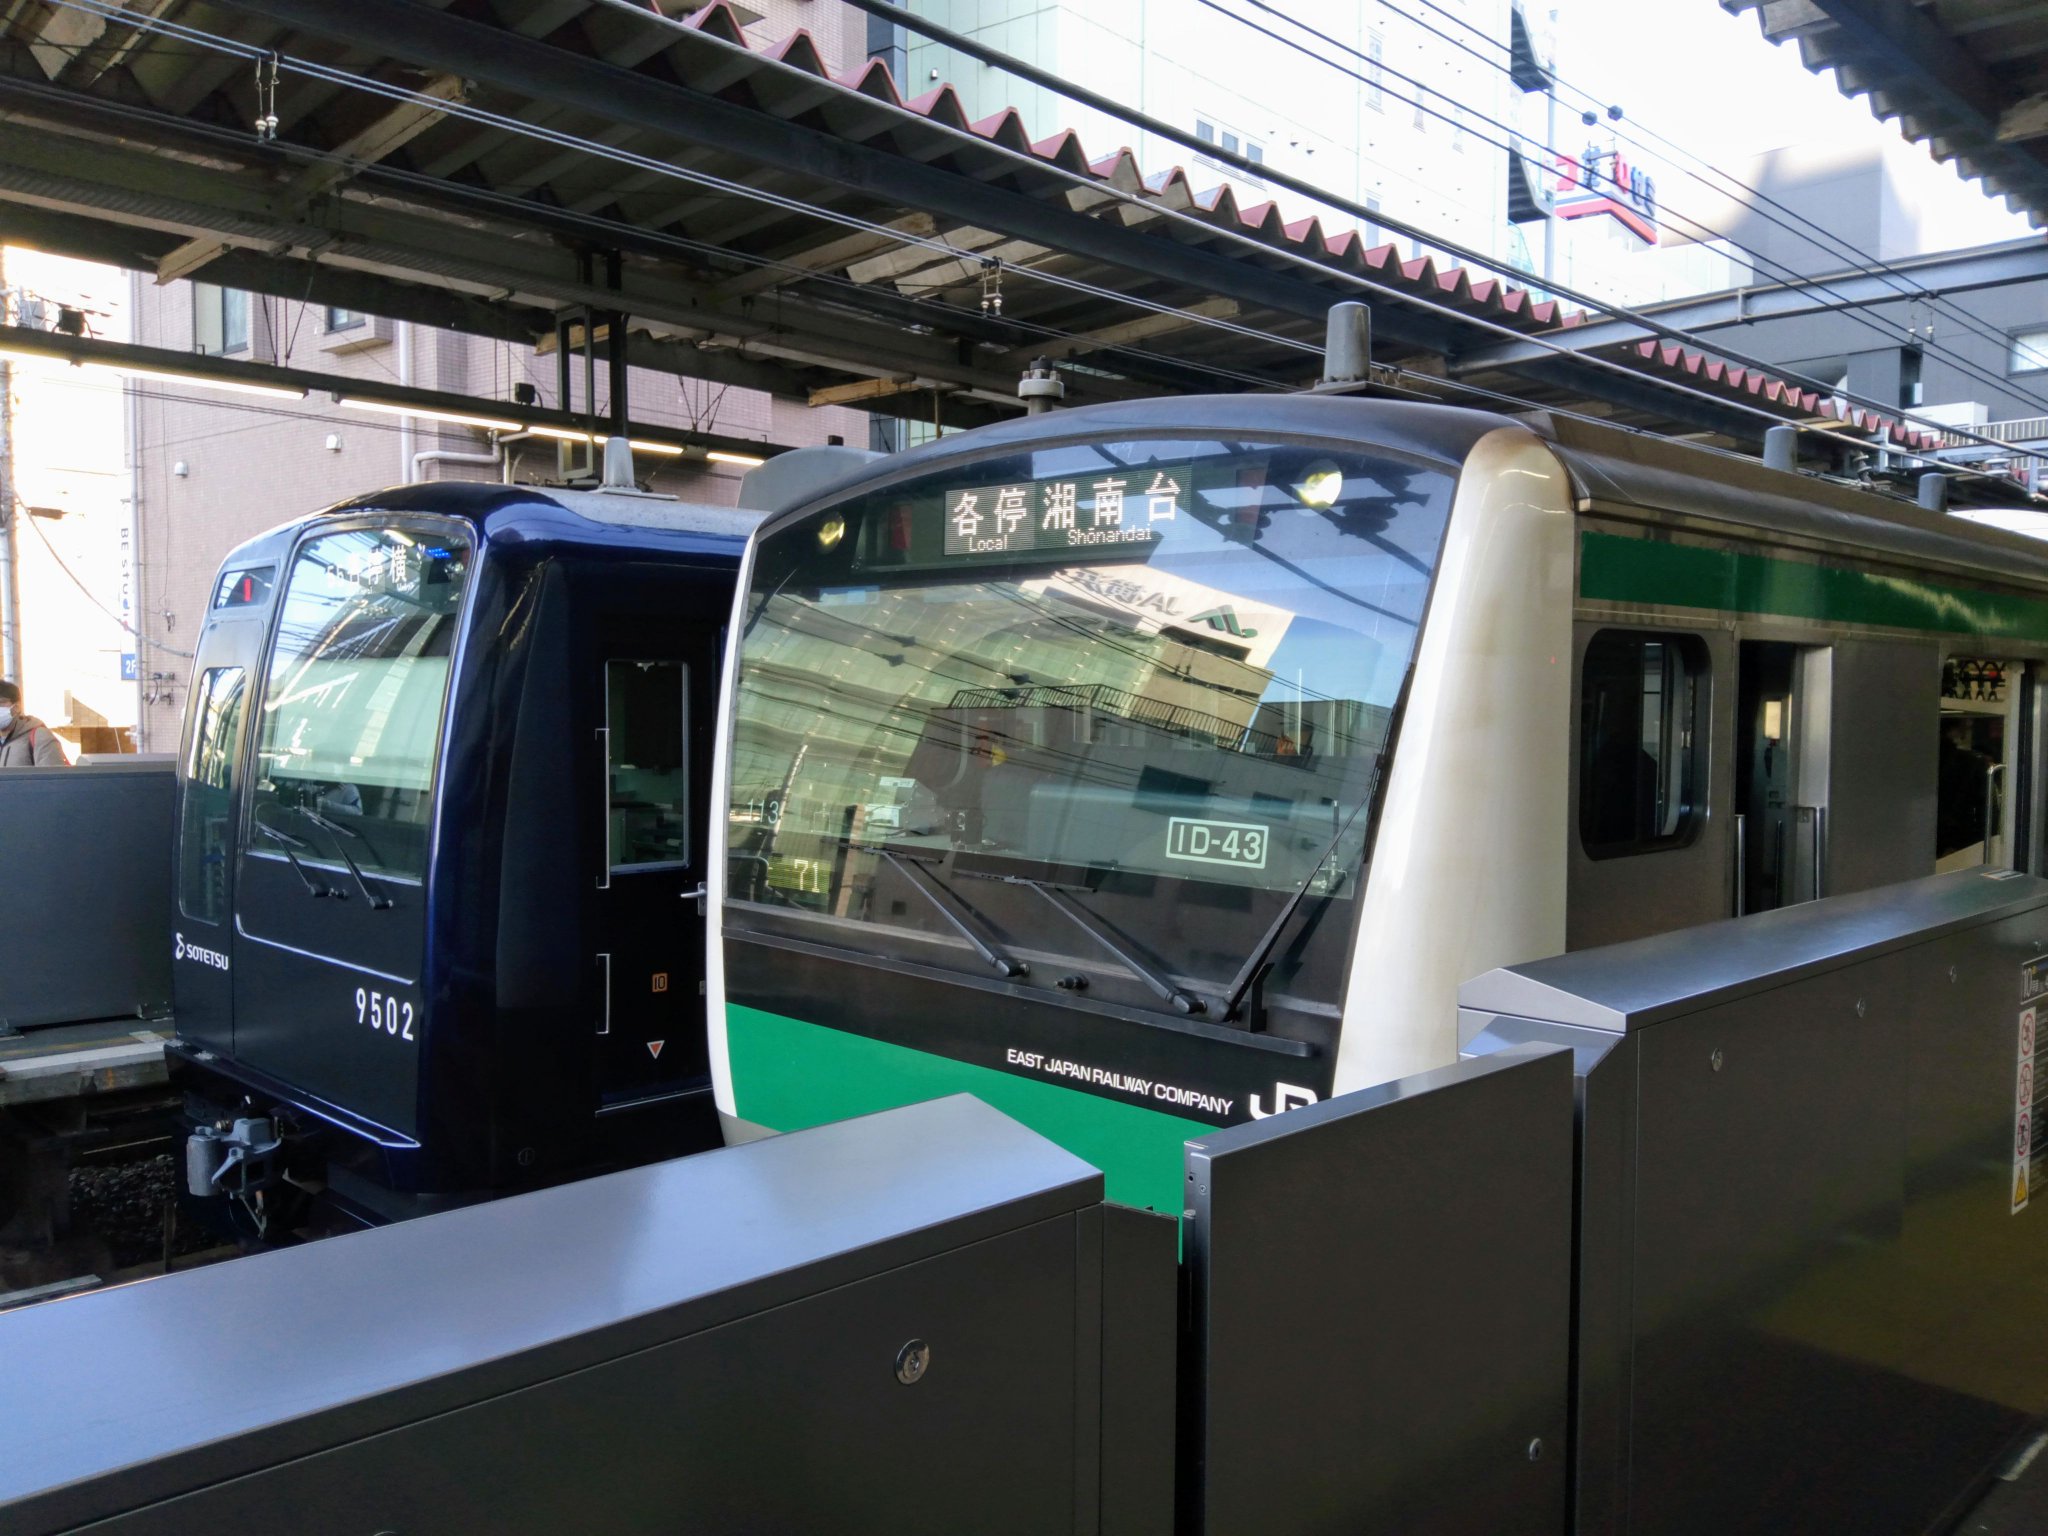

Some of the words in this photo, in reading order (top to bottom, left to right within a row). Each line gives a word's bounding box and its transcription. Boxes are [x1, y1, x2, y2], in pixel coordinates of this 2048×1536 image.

[953, 488, 1027, 537] 各停
[1042, 472, 1181, 531] 湘南台
[968, 535, 1008, 552] Local
[1067, 523, 1152, 546] Shōnandai
[747, 798, 779, 824] 113
[1177, 824, 1262, 861] ID-43
[794, 858, 820, 893] 71
[186, 943, 229, 971] SOTETSU
[356, 987, 414, 1041] 9502
[1007, 1048, 1045, 1070] EAST
[1045, 1057, 1092, 1083] JAPAN
[1092, 1068, 1153, 1096] RAILWAY
[1154, 1083, 1234, 1116] COMPANY
